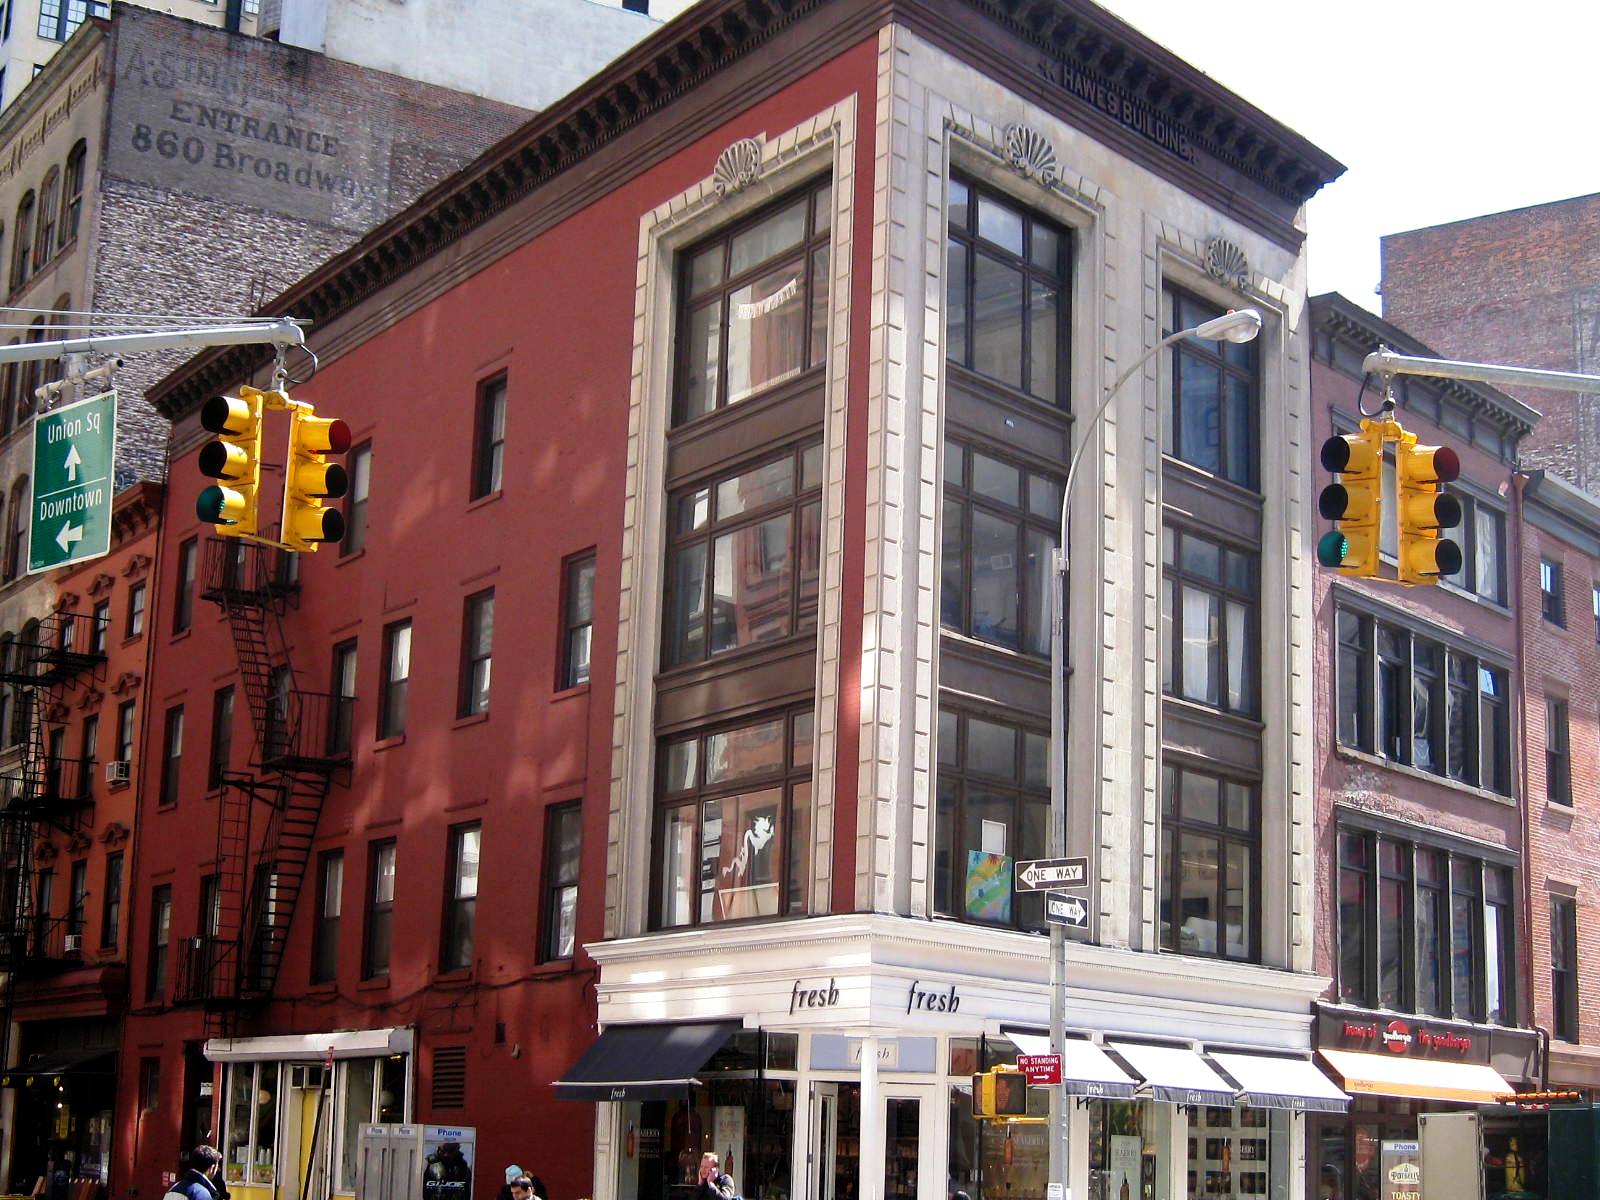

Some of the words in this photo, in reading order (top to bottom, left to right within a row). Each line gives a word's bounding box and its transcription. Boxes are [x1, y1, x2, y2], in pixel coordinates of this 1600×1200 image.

[170, 101, 340, 158] ENTRANCE
[131, 123, 204, 165] 860
[213, 142, 378, 200] Broadway
[47, 419, 81, 444] Union
[86, 411, 101, 435] Sq
[40, 488, 103, 521] Downtown
[1026, 869, 1047, 882] ONE
[1056, 867, 1078, 880] WAY
[1051, 902, 1064, 915] ONE
[1069, 906, 1082, 918] WAY
[789, 977, 840, 1016] fresh
[907, 980, 960, 1015] fresh
[855, 1047, 890, 1061] fsh
[1019, 1057, 1029, 1065] NO
[1030, 1057, 1059, 1065] STANDING
[1025, 1065, 1055, 1073] ANYTIME
[610, 1087, 626, 1100] fresh
[1087, 1083, 1104, 1095] fresh
[1186, 1091, 1202, 1103] fresh
[437, 1128, 462, 1137] Phone
[1391, 1191, 1420, 1200] TOASTY
